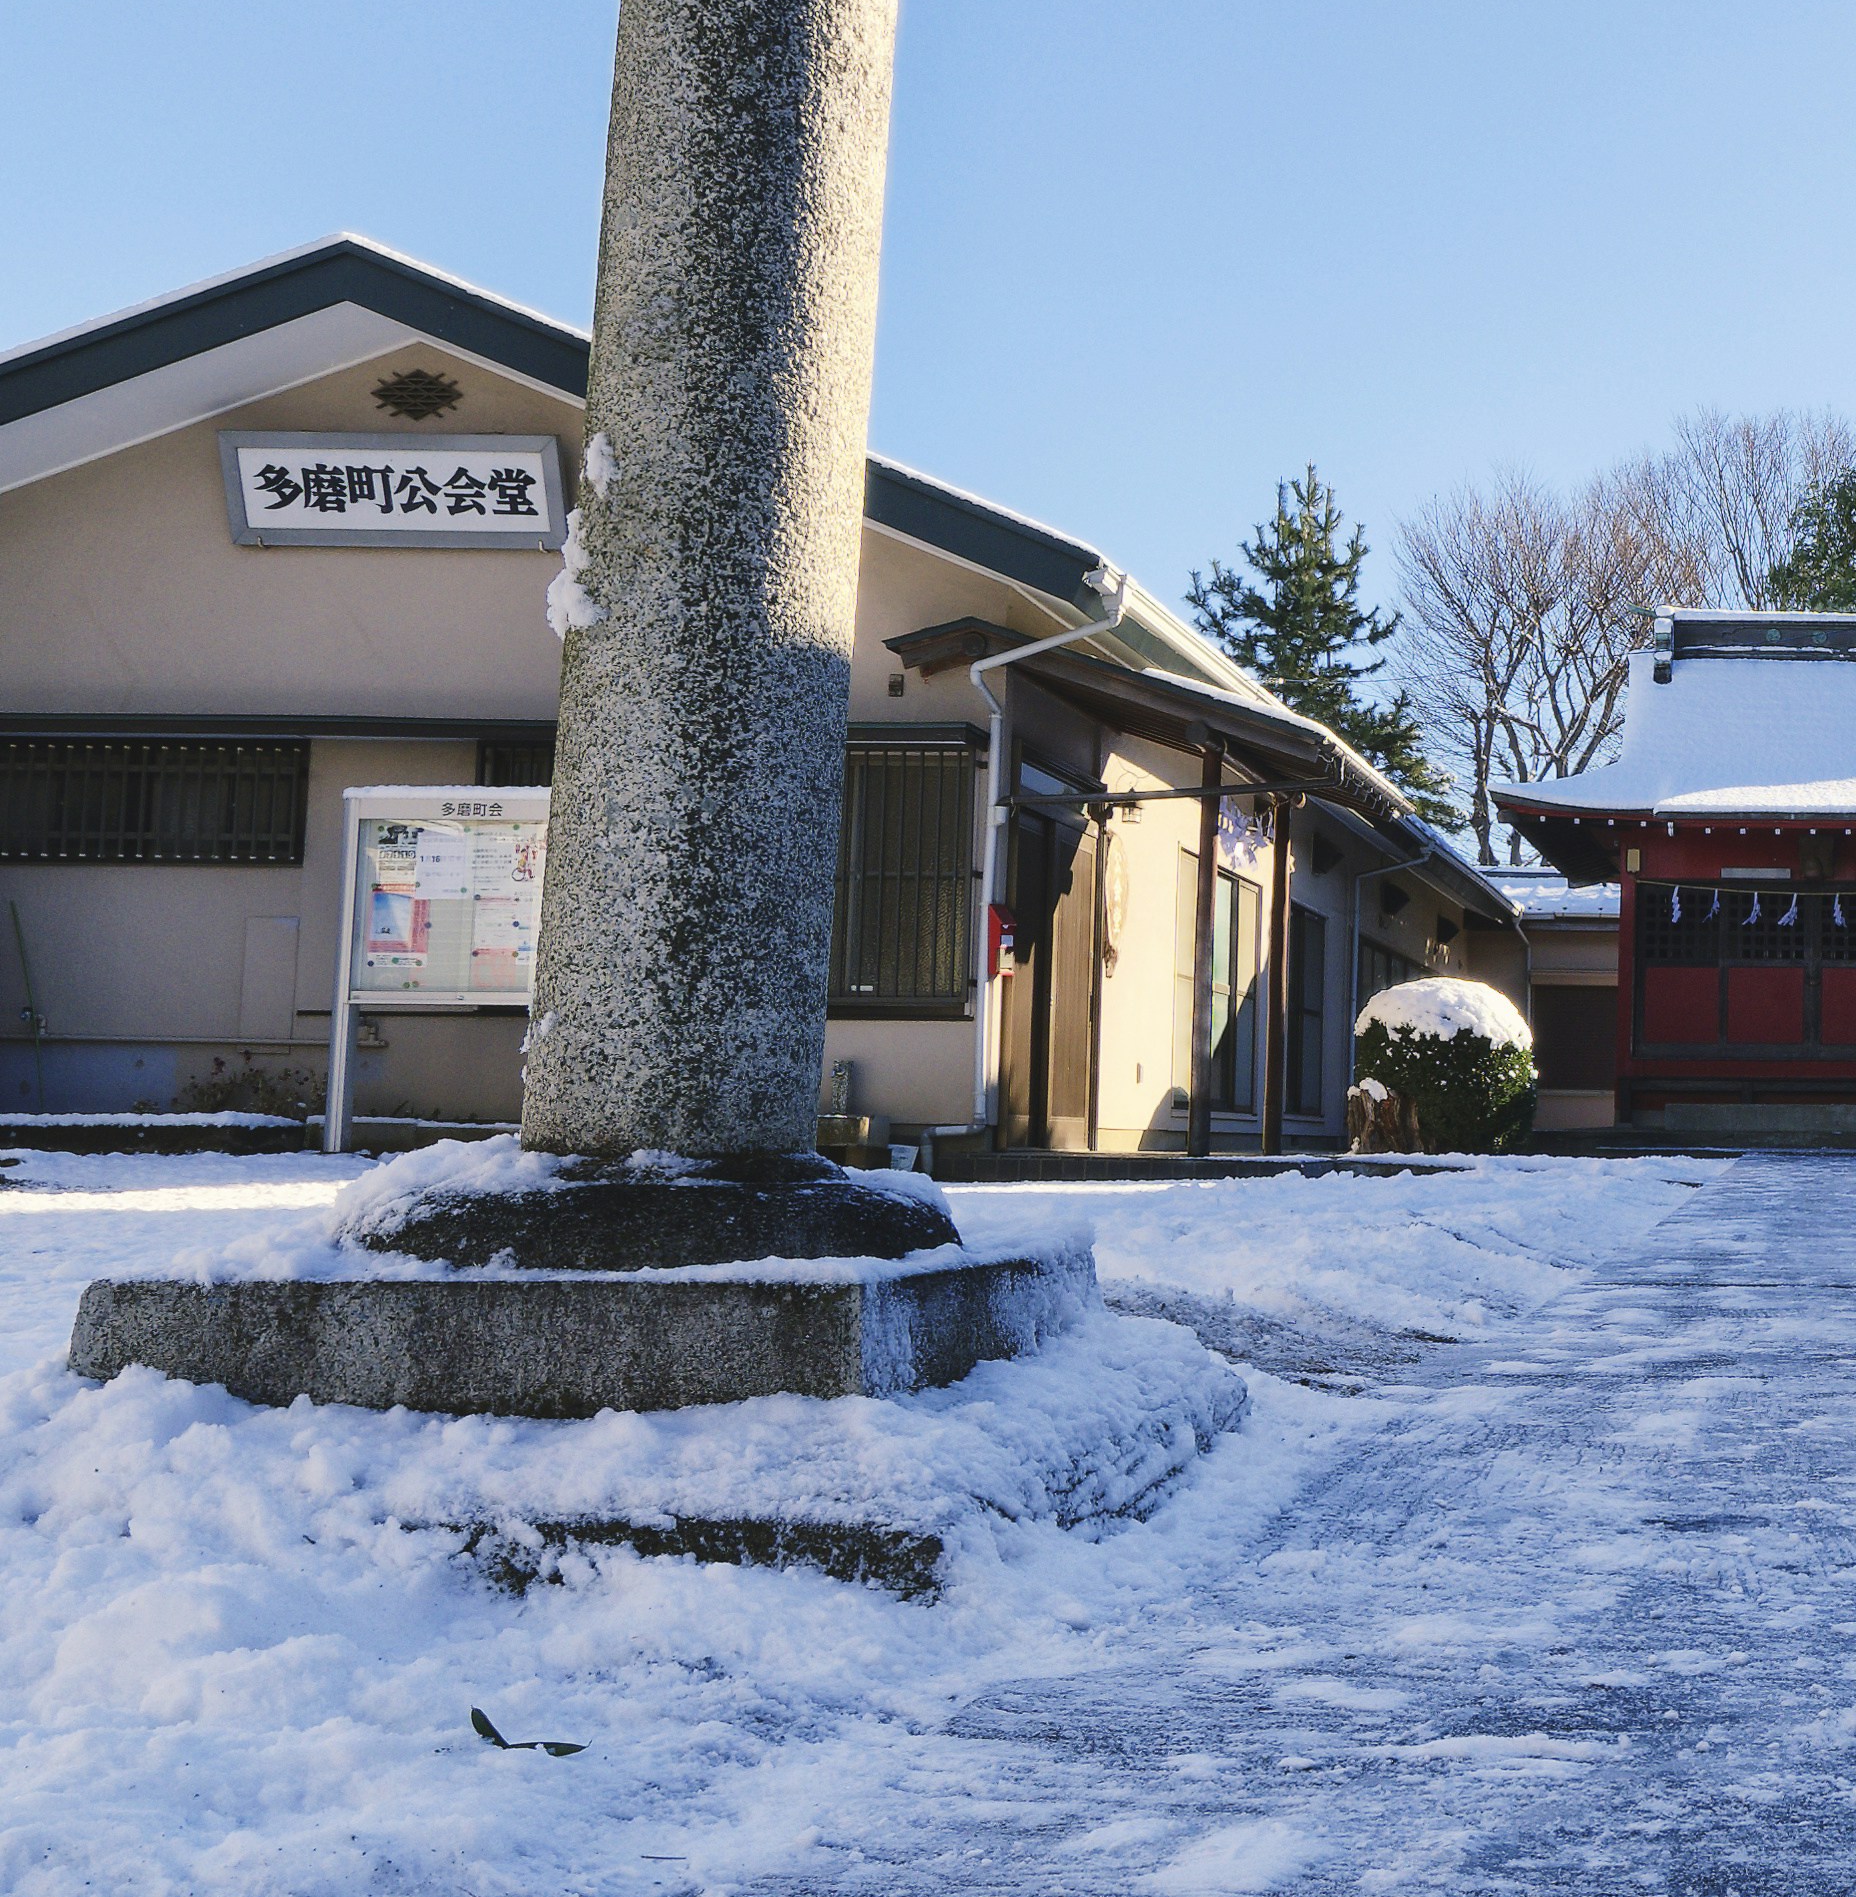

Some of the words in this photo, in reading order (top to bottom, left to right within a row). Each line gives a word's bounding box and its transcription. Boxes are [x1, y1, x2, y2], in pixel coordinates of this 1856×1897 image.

[253, 462, 540, 516] 多磨町公会堂
[441, 802, 503, 817] 多磨町会
